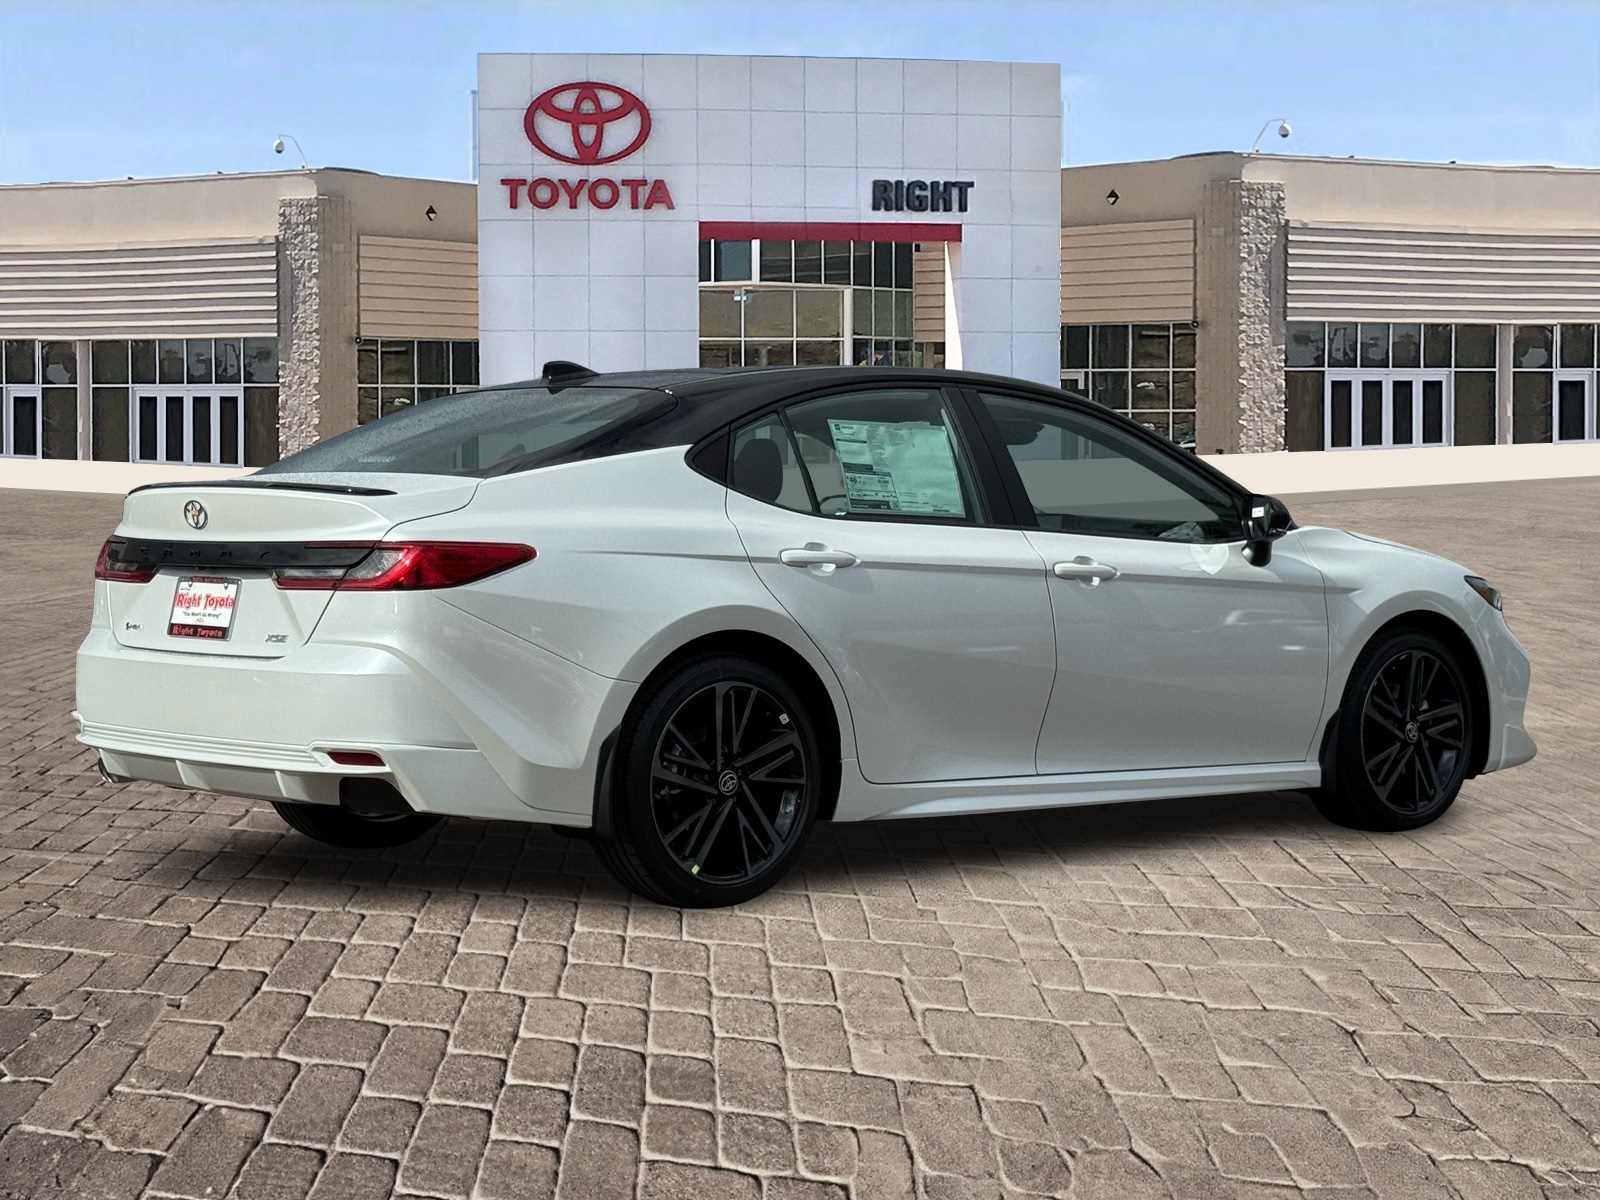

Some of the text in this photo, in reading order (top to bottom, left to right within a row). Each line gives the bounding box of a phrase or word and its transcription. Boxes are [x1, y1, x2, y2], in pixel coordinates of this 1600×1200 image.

[500, 179, 675, 212] TOYOTA
[872, 179, 975, 213] RIGHT
[176, 593, 235, 611] Right Toyota
[172, 625, 223, 637] Right Toyota
[265, 634, 289, 643] XSE
